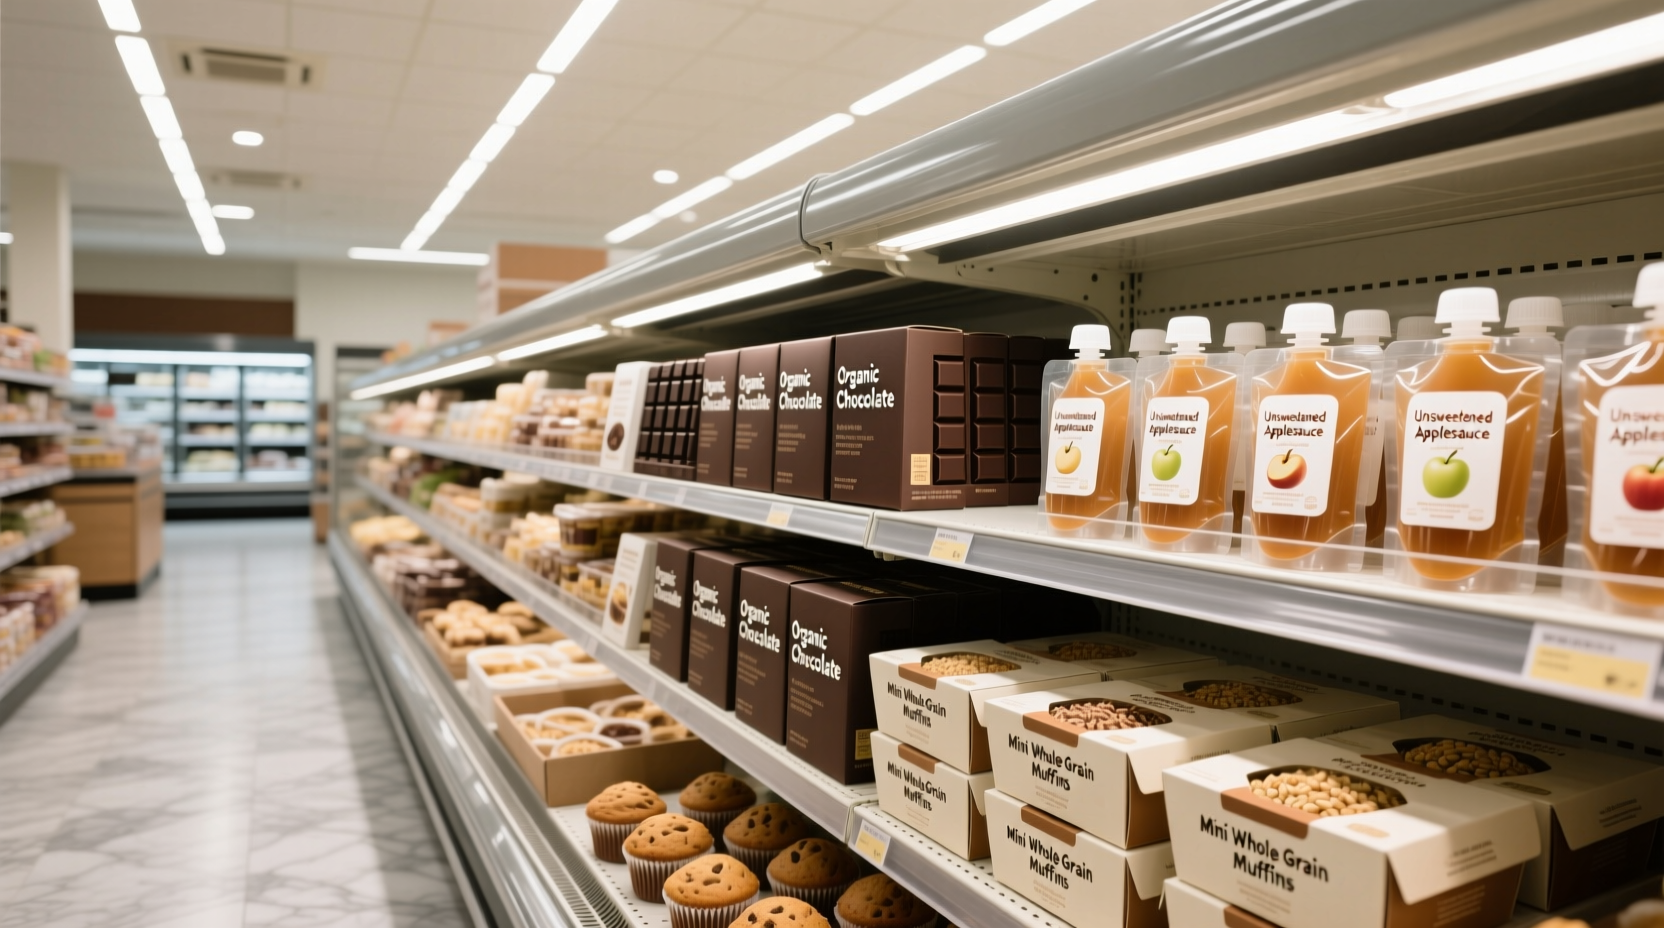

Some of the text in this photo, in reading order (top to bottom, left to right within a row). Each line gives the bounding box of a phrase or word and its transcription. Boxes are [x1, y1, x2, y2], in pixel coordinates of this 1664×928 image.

[837, 363, 880, 389] Organic
[837, 387, 895, 409] Chocolate
[1415, 410, 1493, 423] Unsweetened
[1415, 426, 1490, 442] Applesauce
[1064, 756, 1094, 781] Grain
[1029, 836, 1060, 865] Whole
[1062, 854, 1093, 883] Grain
[1232, 827, 1279, 861] Whole
[1283, 848, 1329, 883] Grain
[1234, 852, 1295, 893] Muffins
